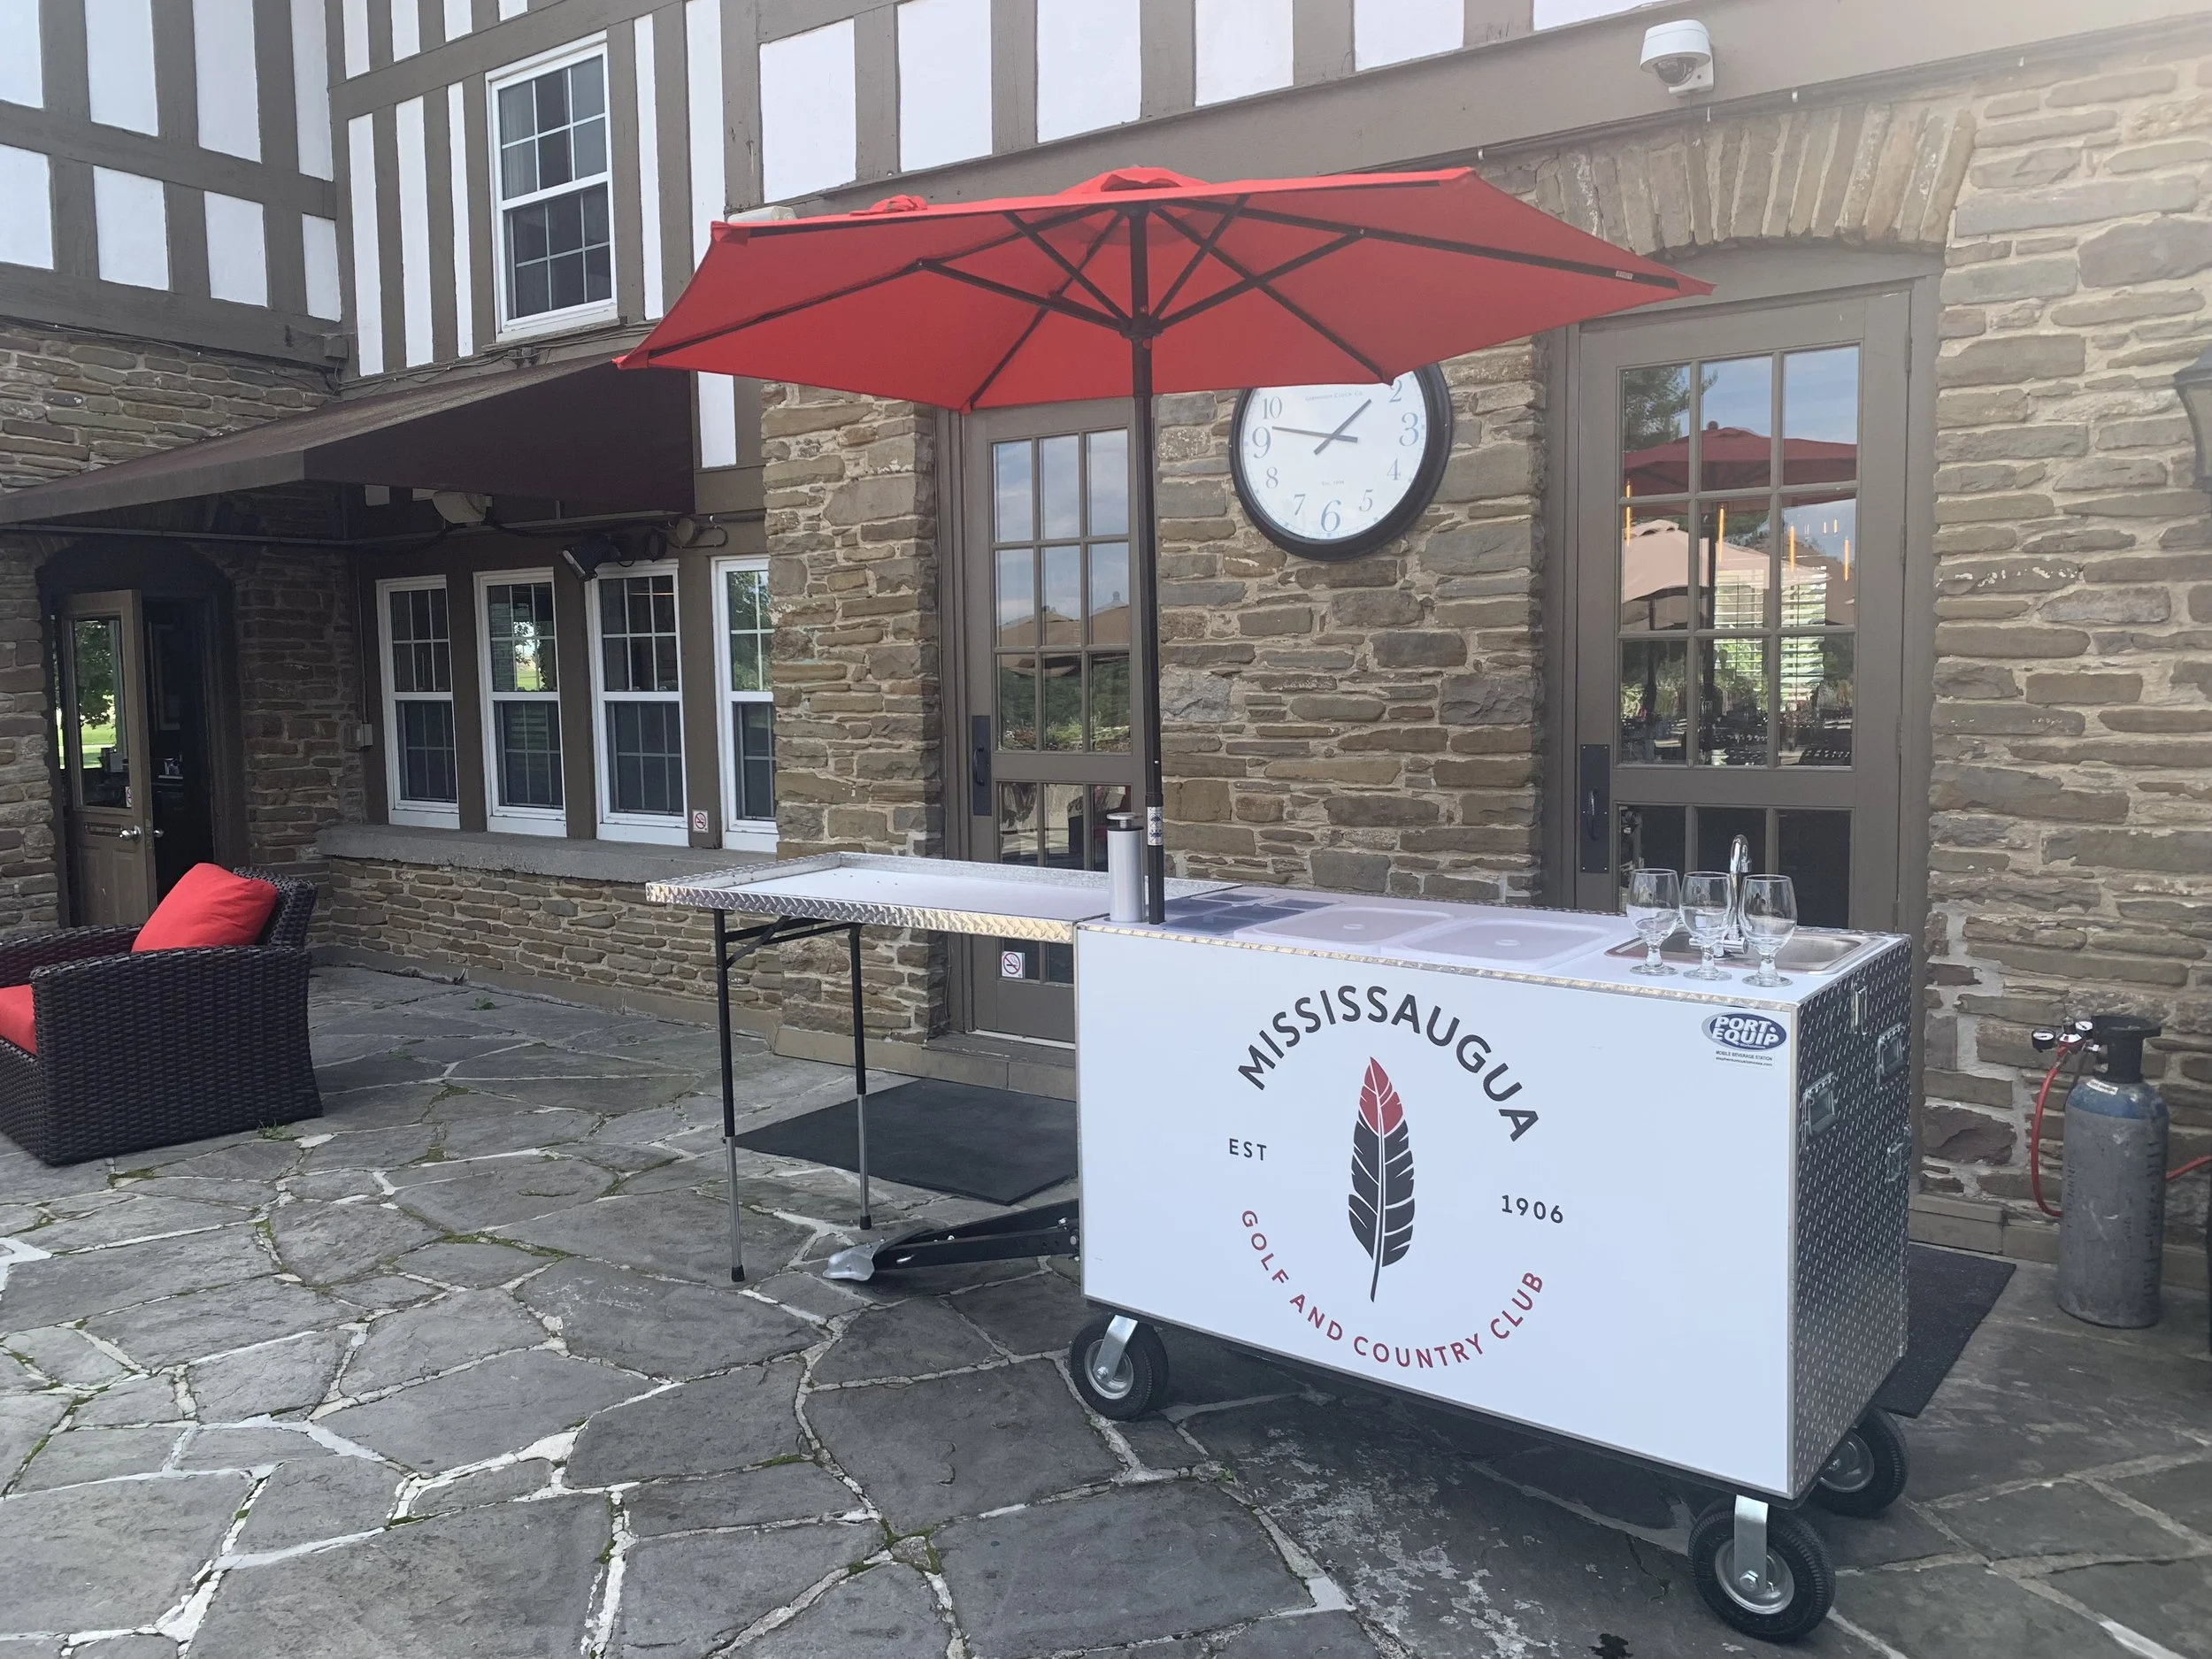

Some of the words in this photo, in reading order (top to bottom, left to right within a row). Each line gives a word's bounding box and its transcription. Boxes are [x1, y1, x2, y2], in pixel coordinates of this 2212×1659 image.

[1389, 380, 1402, 403] 2
[1263, 396, 1282, 419] 10
[1399, 412, 1419, 446] 3
[1252, 426, 1271, 458] 9
[1265, 467, 1279, 488] 8
[1386, 459, 1402, 480] 4
[1294, 494, 1306, 516] 7
[1359, 489, 1373, 511] 5
[1321, 500, 1341, 532] 6
[1711, 1026, 1779, 1046] EQUIP
[1238, 985, 1540, 1142] MISSISSAUGUA
[1229, 1138, 1267, 1161] EST
[1502, 1194, 1563, 1224] 1906
[1241, 1210, 1290, 1284] GOLF
[1288, 1294, 1343, 1341] AND
[1353, 1333, 1484, 1369] COUNTRY
[1490, 1272, 1543, 1340] CLUB
